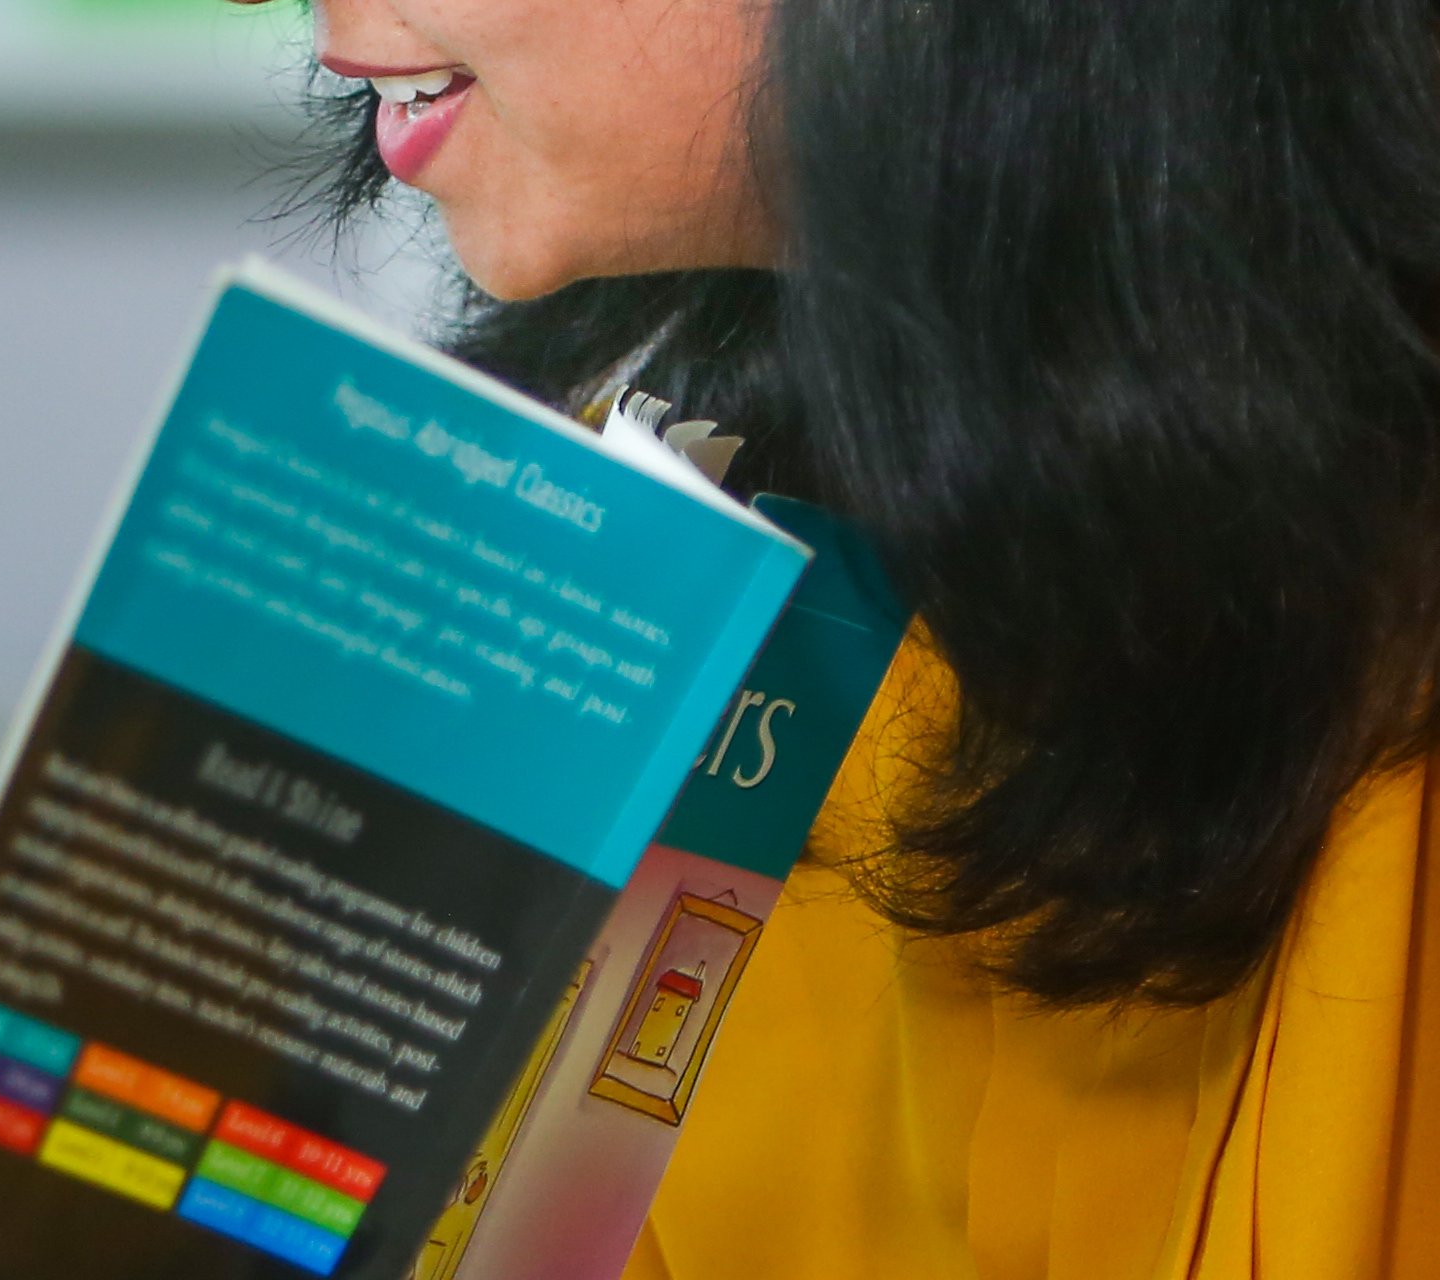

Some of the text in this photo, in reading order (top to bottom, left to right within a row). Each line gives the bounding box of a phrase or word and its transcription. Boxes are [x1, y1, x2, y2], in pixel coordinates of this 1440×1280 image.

[515, 464, 608, 530] Classics
[616, 655, 657, 686] with
[693, 690, 796, 788] rs
[410, 912, 436, 935] for
[436, 925, 501, 966] children
[383, 949, 433, 981] stories
[434, 968, 483, 1003] which
[362, 982, 413, 1016] stories
[413, 1002, 465, 1039] based
[322, 1051, 388, 1091] materials
[390, 1081, 426, 1108] and
[397, 1045, 441, 1077] post-
